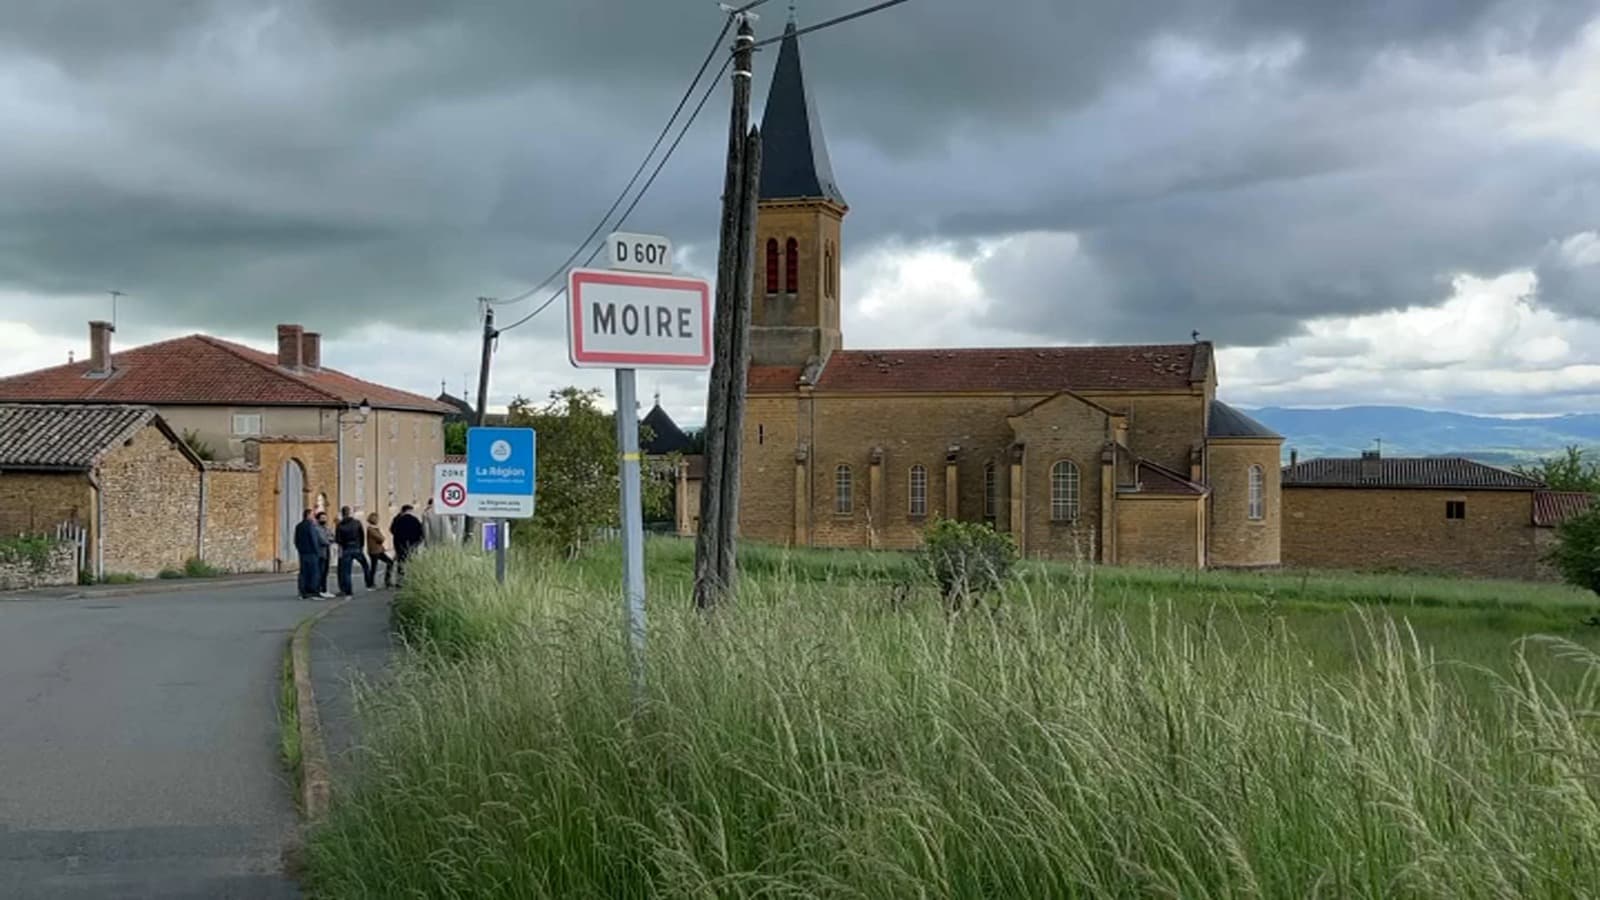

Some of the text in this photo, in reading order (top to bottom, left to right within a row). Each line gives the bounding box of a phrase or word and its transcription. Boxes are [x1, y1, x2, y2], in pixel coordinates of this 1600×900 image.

[616, 241, 667, 265] D 607
[592, 302, 693, 338] MOIRE
[441, 469, 464, 477] ZONE
[475, 465, 525, 478] La Région
[446, 489, 461, 501] 30
